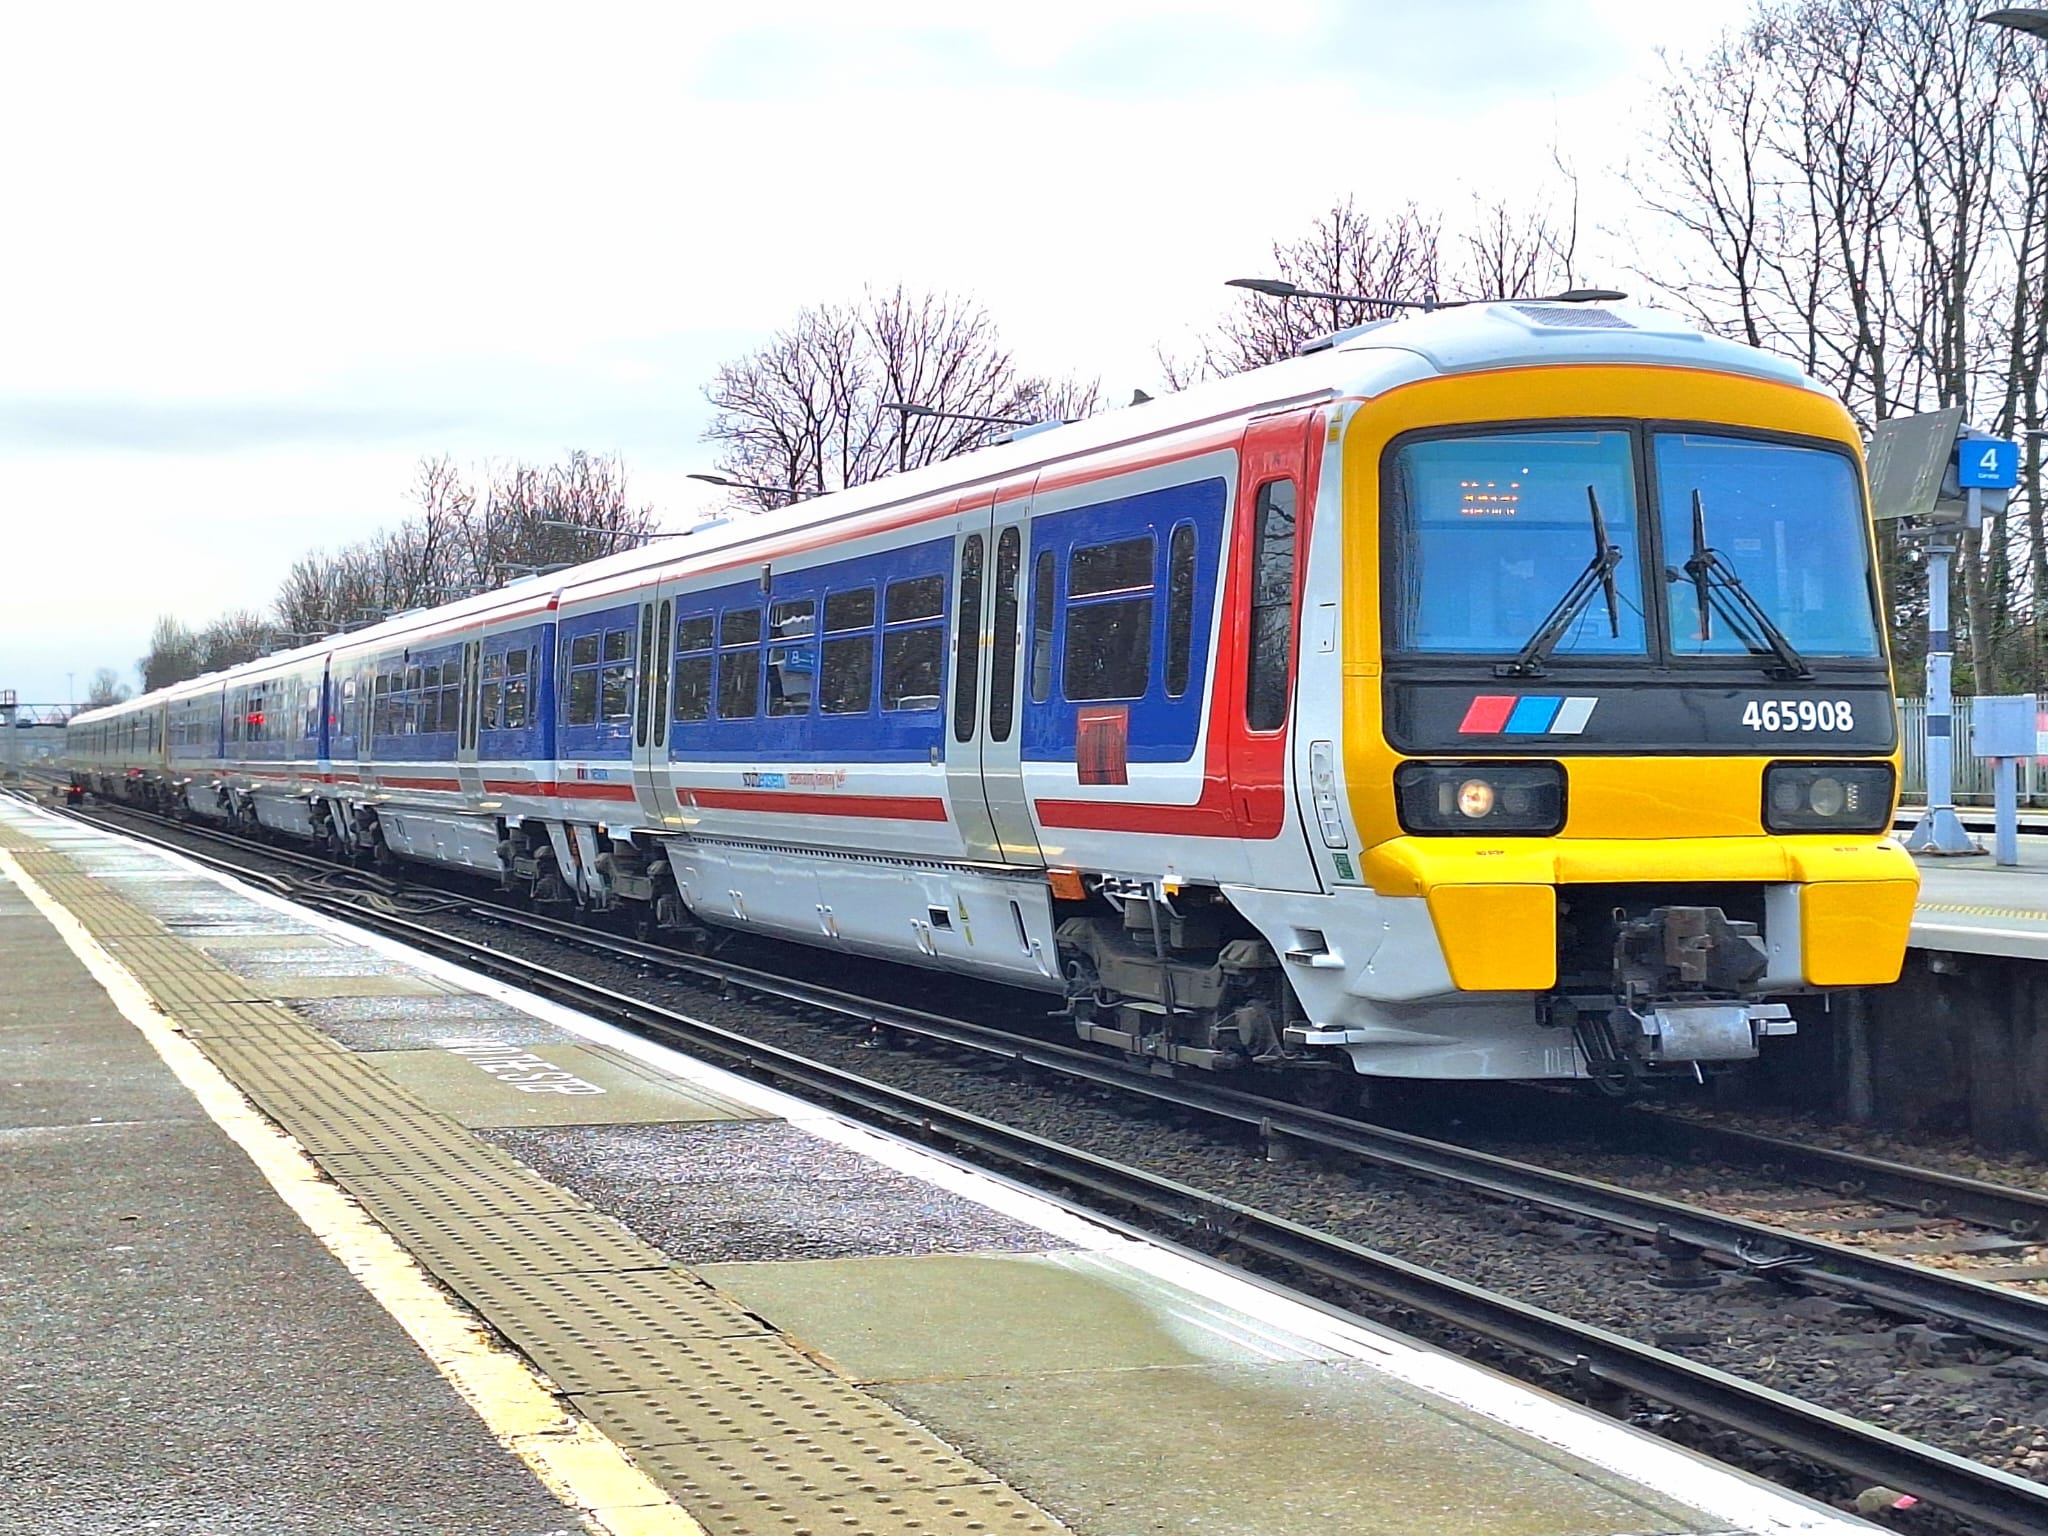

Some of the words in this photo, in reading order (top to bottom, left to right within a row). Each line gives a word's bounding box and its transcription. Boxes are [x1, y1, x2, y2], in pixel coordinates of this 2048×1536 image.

[1980, 448, 1998, 471] 4
[1742, 701, 1853, 731] 465908
[467, 1054, 560, 1073] THE
[497, 1072, 607, 1095] STEP
